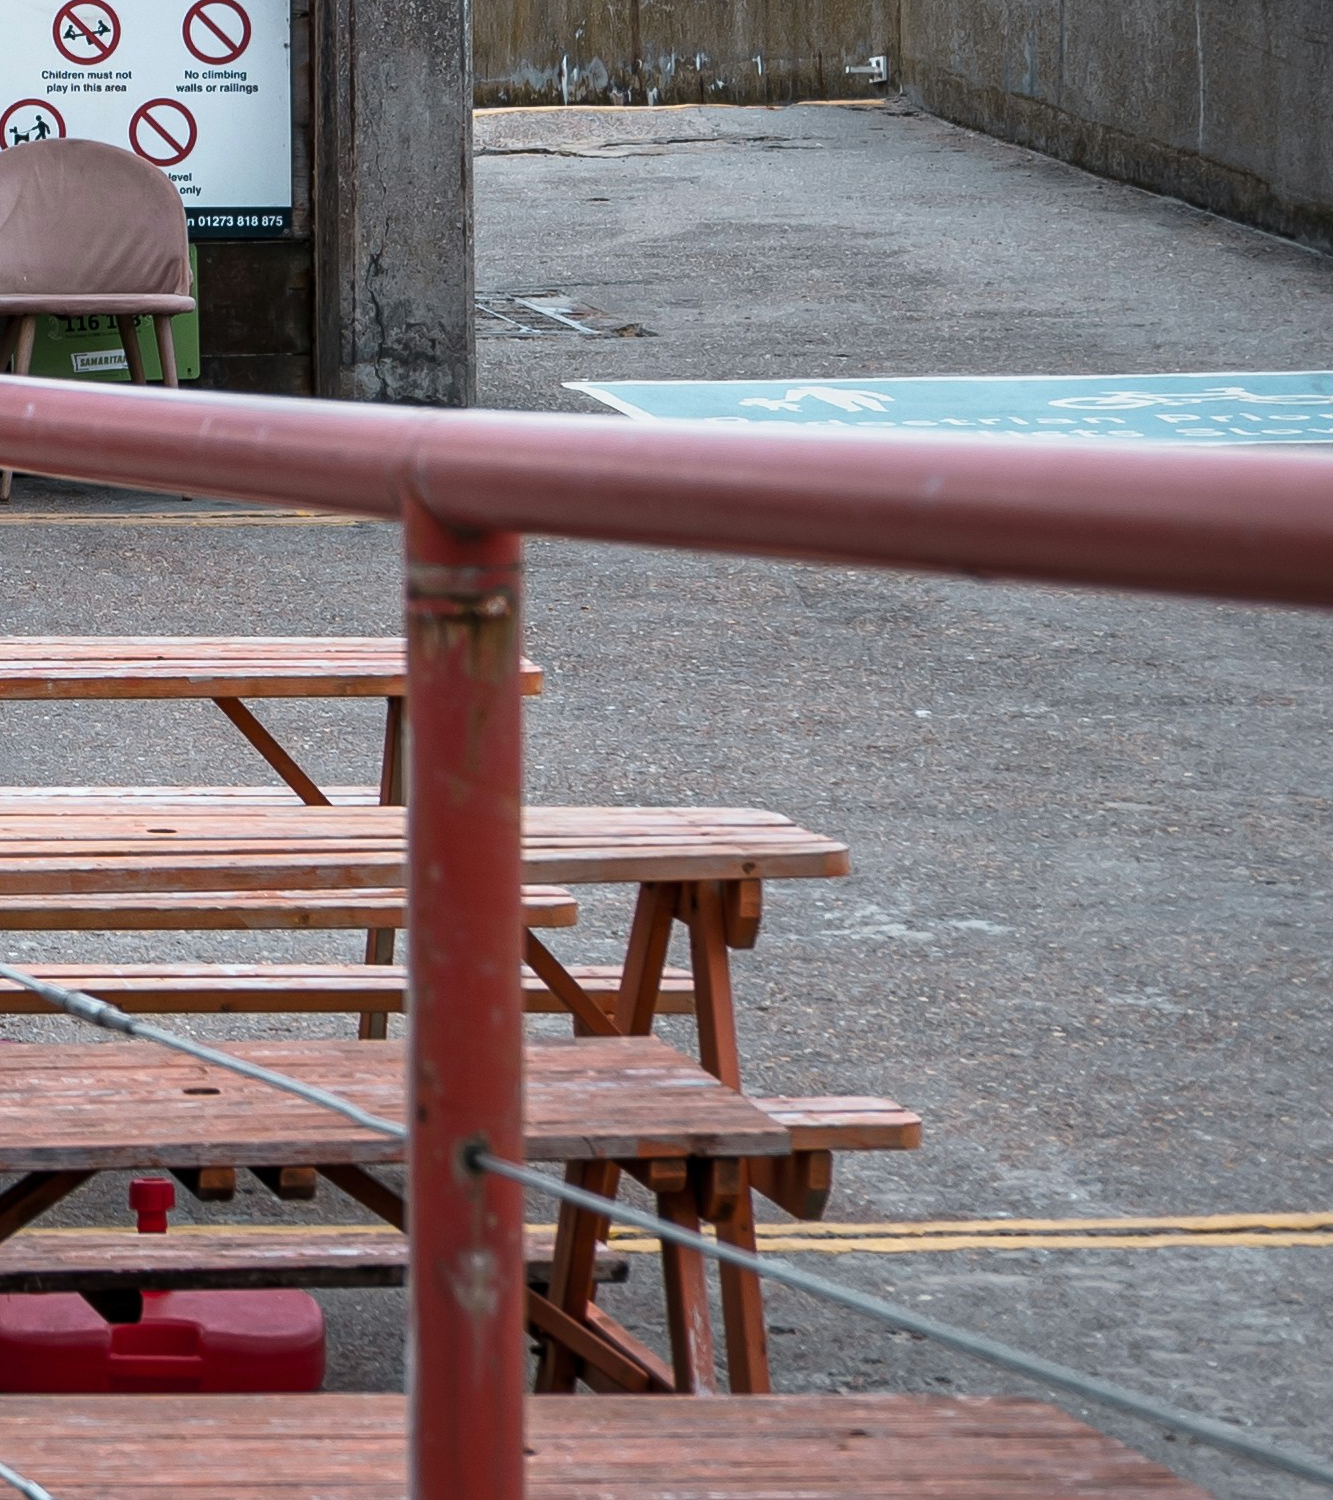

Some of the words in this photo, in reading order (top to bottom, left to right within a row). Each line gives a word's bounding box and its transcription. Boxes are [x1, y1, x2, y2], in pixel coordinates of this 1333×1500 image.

[41, 70, 85, 80] Children
[87, 70, 113, 80] must
[115, 70, 132, 80] not
[184, 70, 200, 80] No
[201, 69, 247, 82] climbing
[46, 83, 69, 95] play
[70, 83, 81, 92] in
[83, 83, 103, 93] this
[104, 84, 127, 93] area
[175, 83, 203, 93] walls
[205, 84, 217, 93] or
[219, 82, 259, 95] railings
[179, 185, 202, 196] only
[197, 215, 234, 227] 01273
[236, 215, 259, 227] 818
[261, 215, 283, 227] 875
